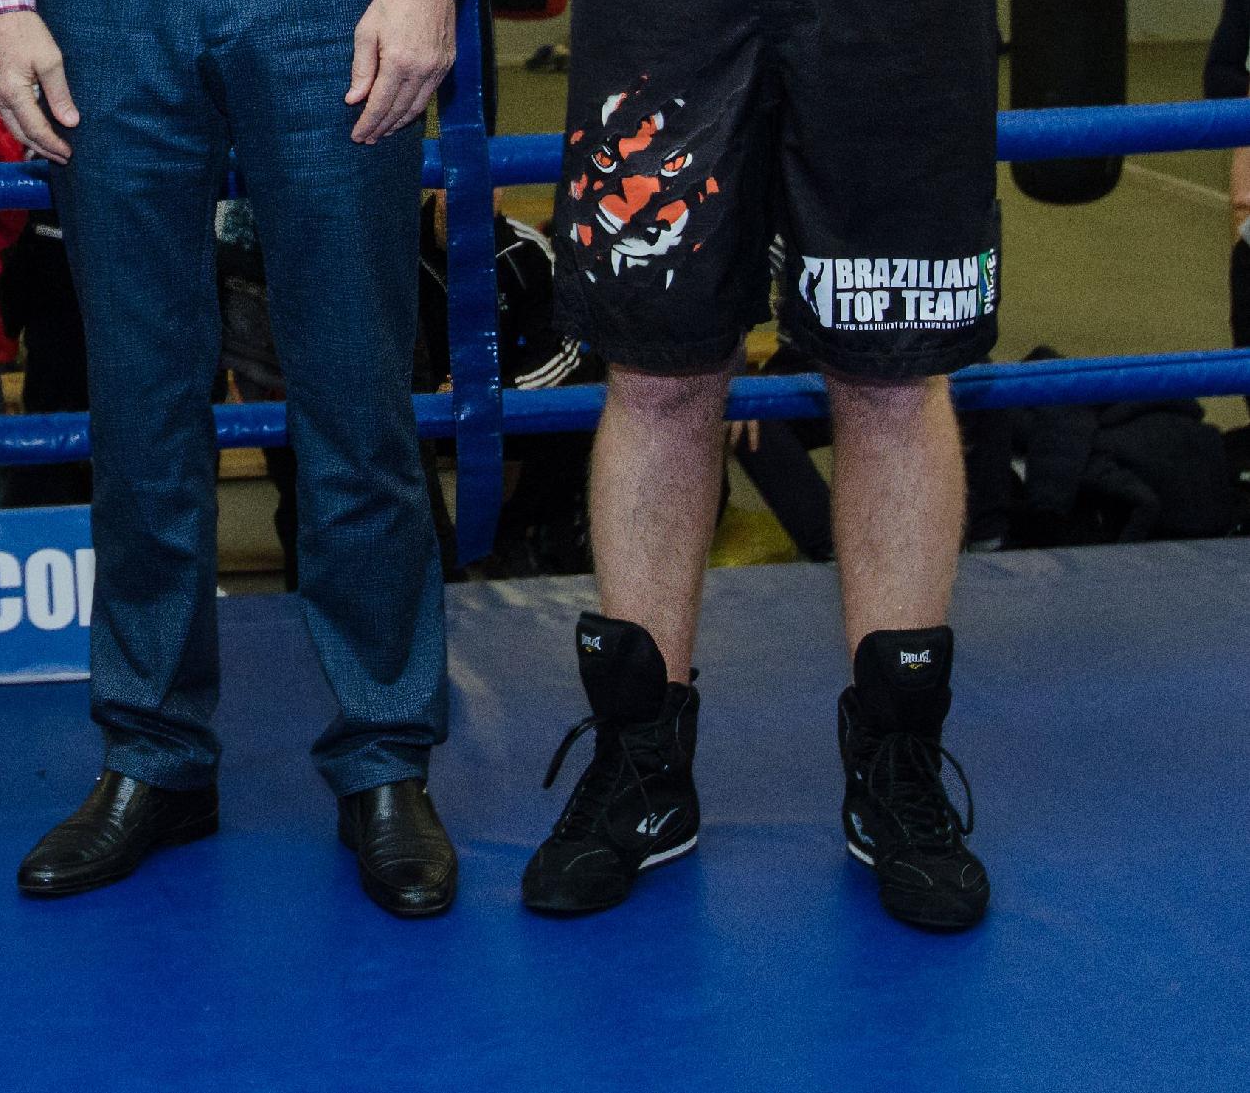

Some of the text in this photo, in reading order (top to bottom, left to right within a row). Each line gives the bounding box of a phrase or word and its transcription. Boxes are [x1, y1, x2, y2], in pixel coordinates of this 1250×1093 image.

[835, 256, 978, 289] BRAZILIAN
[836, 288, 977, 322] TOP TEAM
